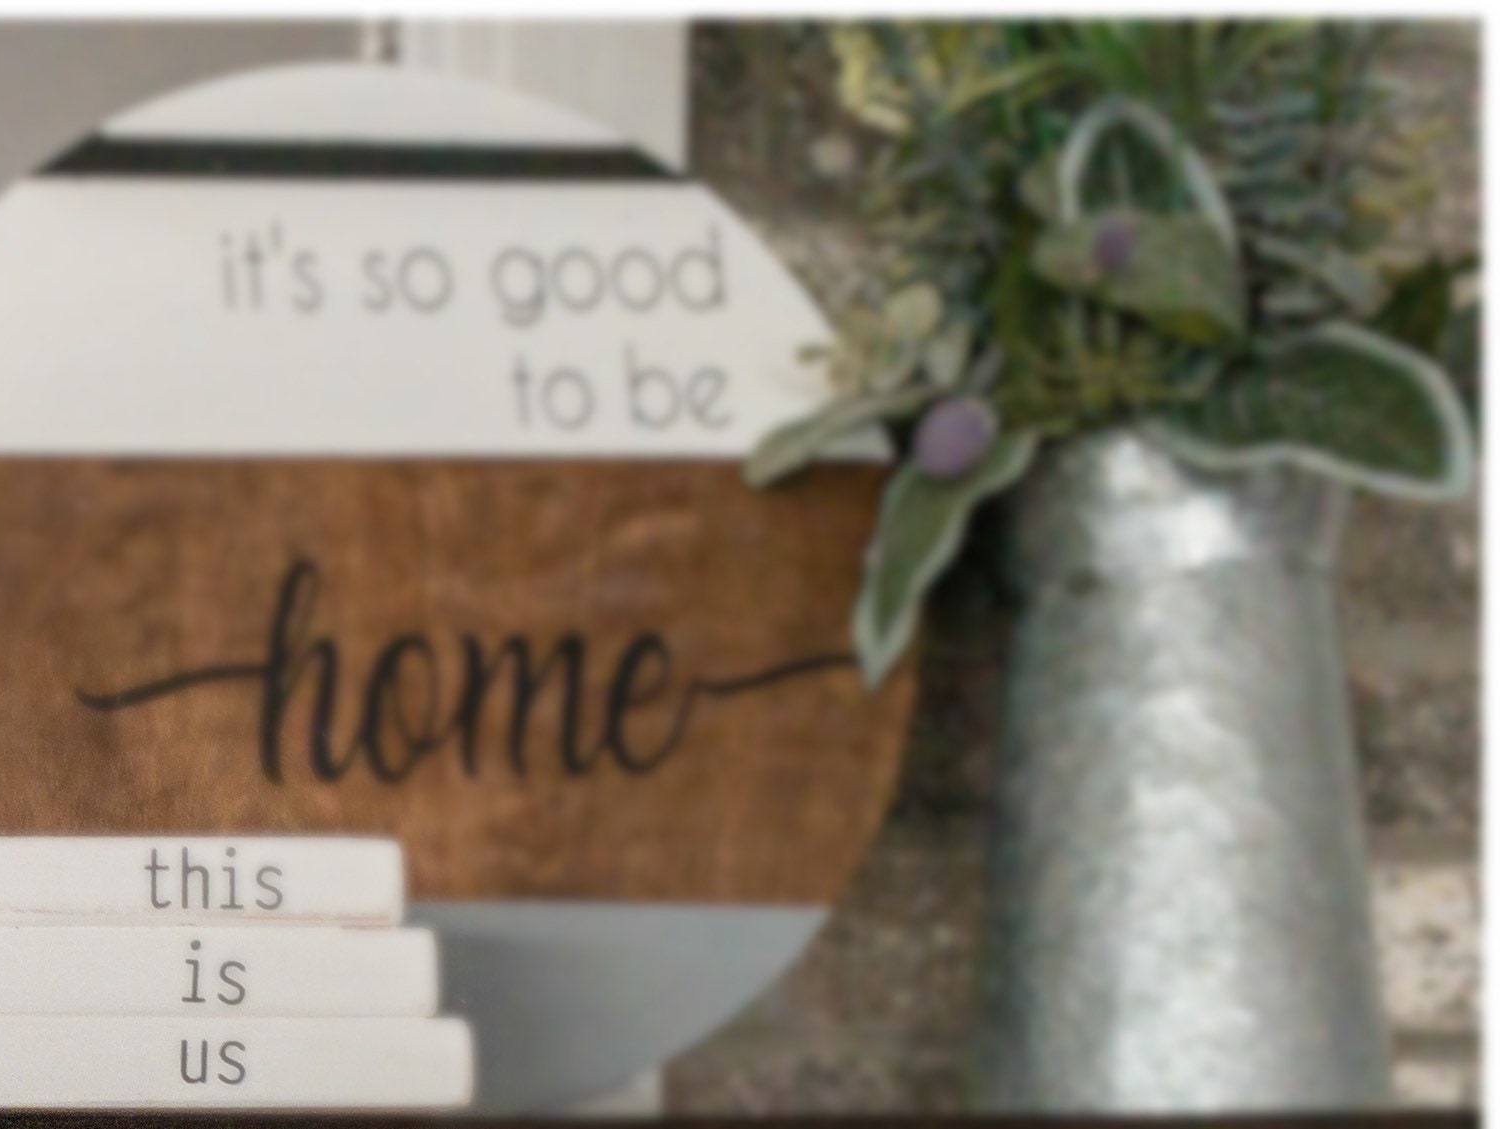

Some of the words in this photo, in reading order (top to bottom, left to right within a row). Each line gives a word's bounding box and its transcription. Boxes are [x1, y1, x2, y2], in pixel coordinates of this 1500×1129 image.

[219, 220, 323, 314] it's
[361, 244, 454, 314] so
[491, 222, 730, 327] good
[512, 352, 596, 431] to
[625, 340, 736, 431] be
[75, 556, 862, 784] home
[143, 846, 284, 910] this
[181, 940, 248, 1006] is
[179, 1038, 248, 1085] us
